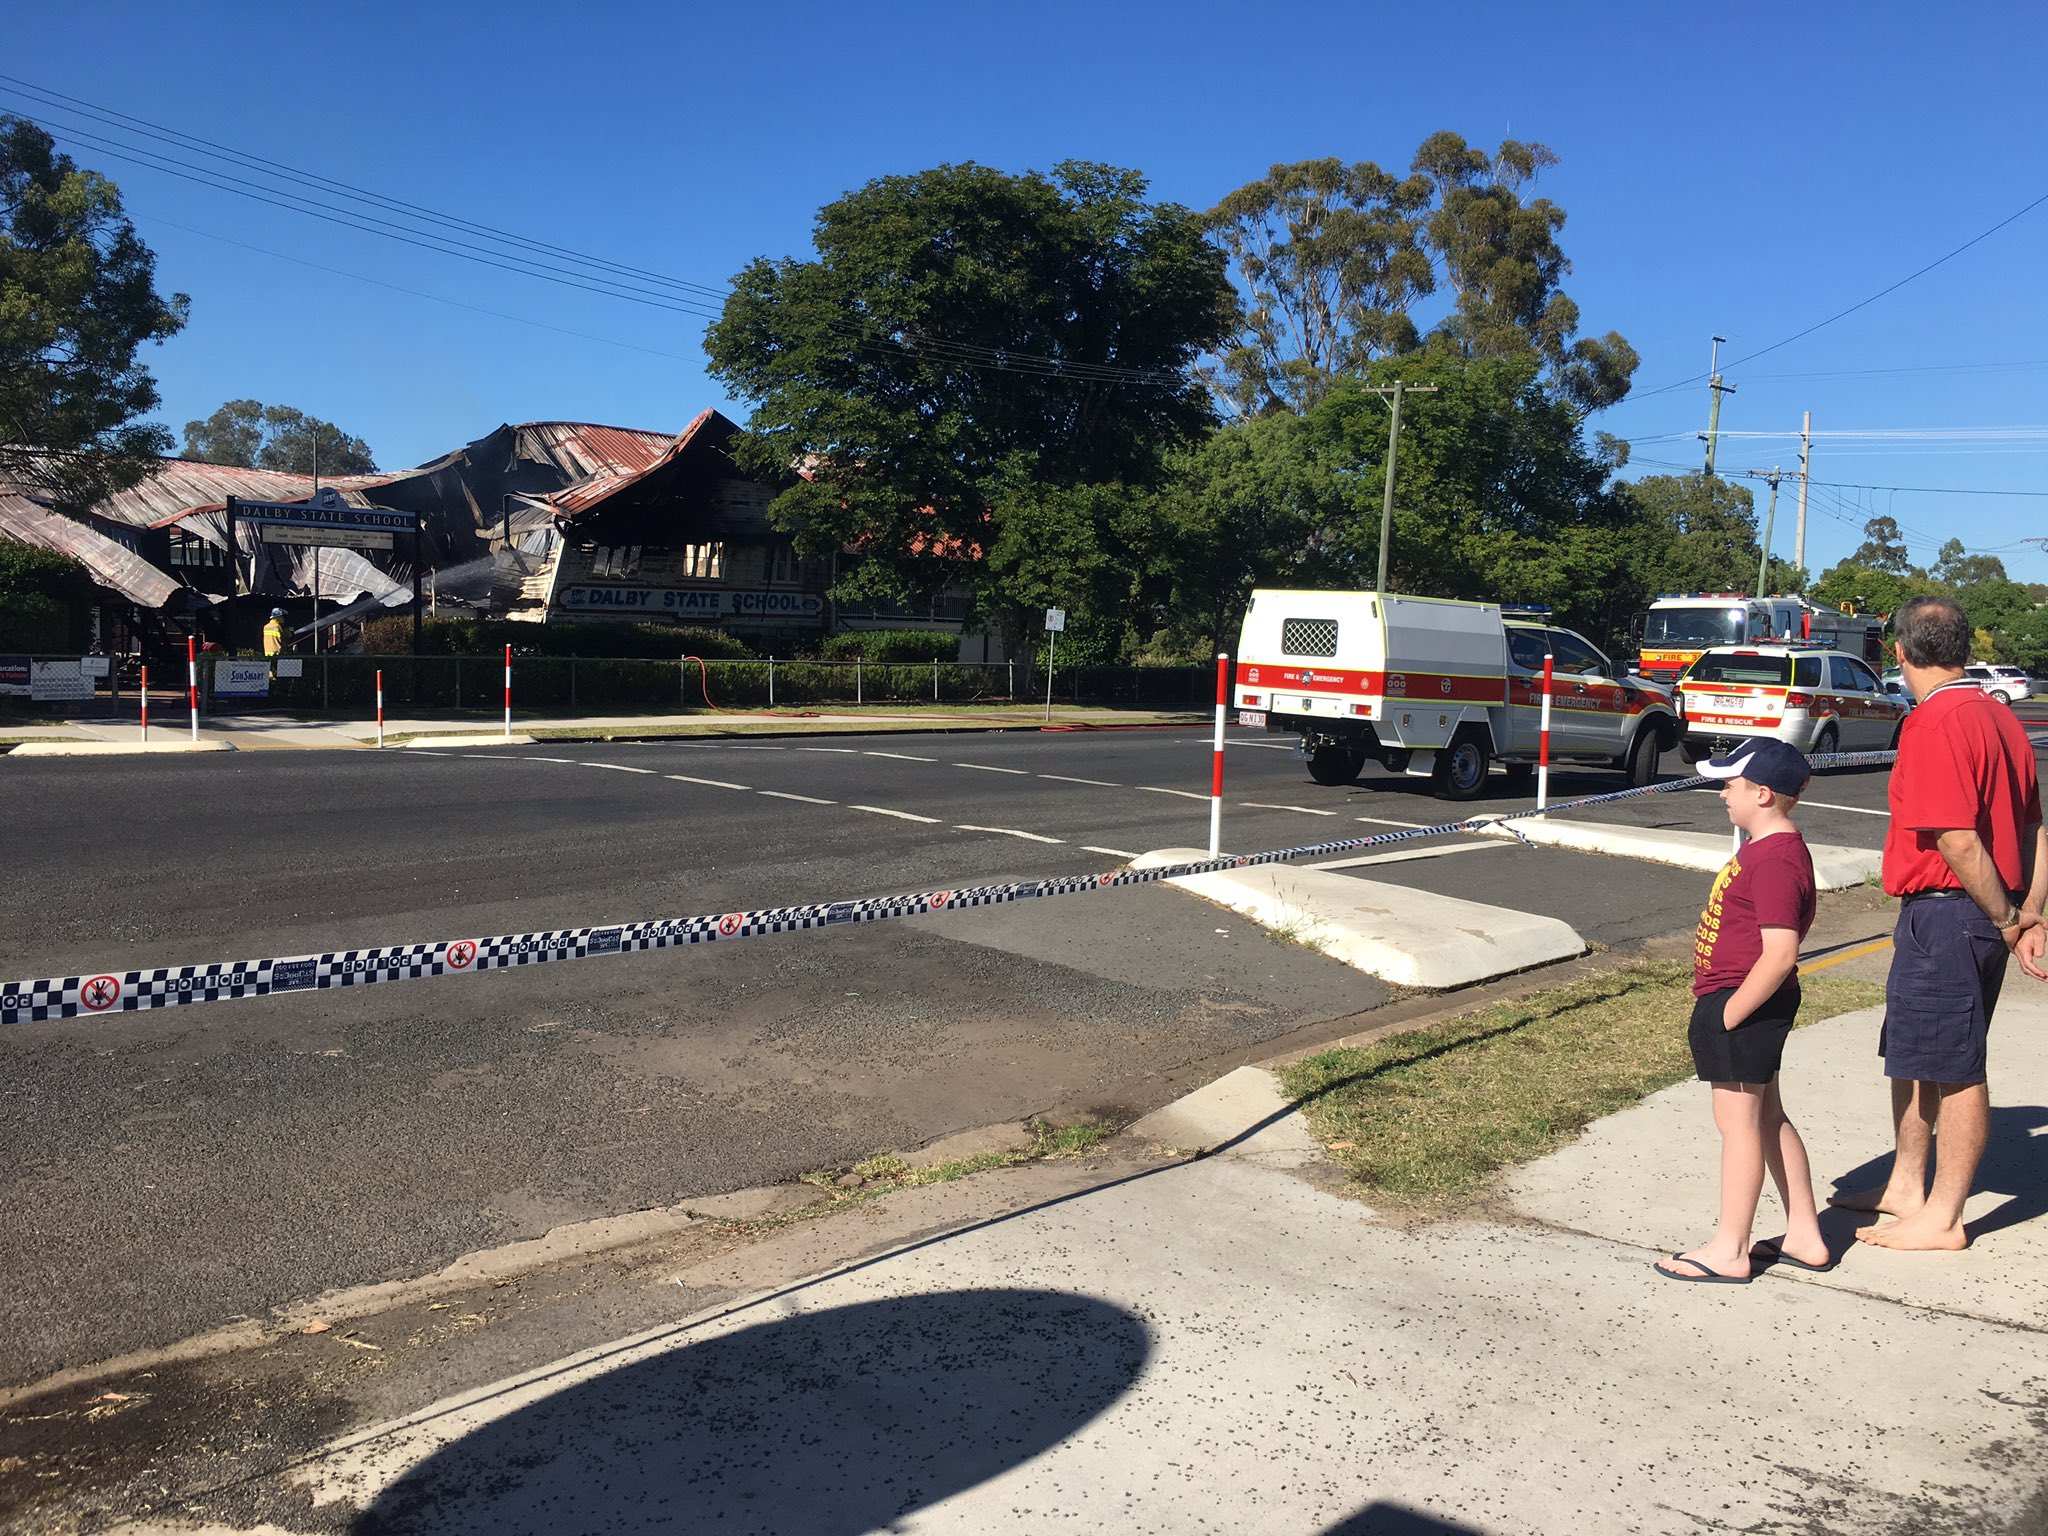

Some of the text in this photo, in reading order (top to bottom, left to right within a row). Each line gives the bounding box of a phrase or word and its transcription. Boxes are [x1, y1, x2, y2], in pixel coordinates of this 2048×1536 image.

[242, 506, 410, 527] DALBY STATE SCHOOL
[588, 589, 800, 610] DALBY STATE SCHOOL
[1556, 695, 1601, 709] EMERGENCY
[1725, 718, 1754, 726] RESCUE
